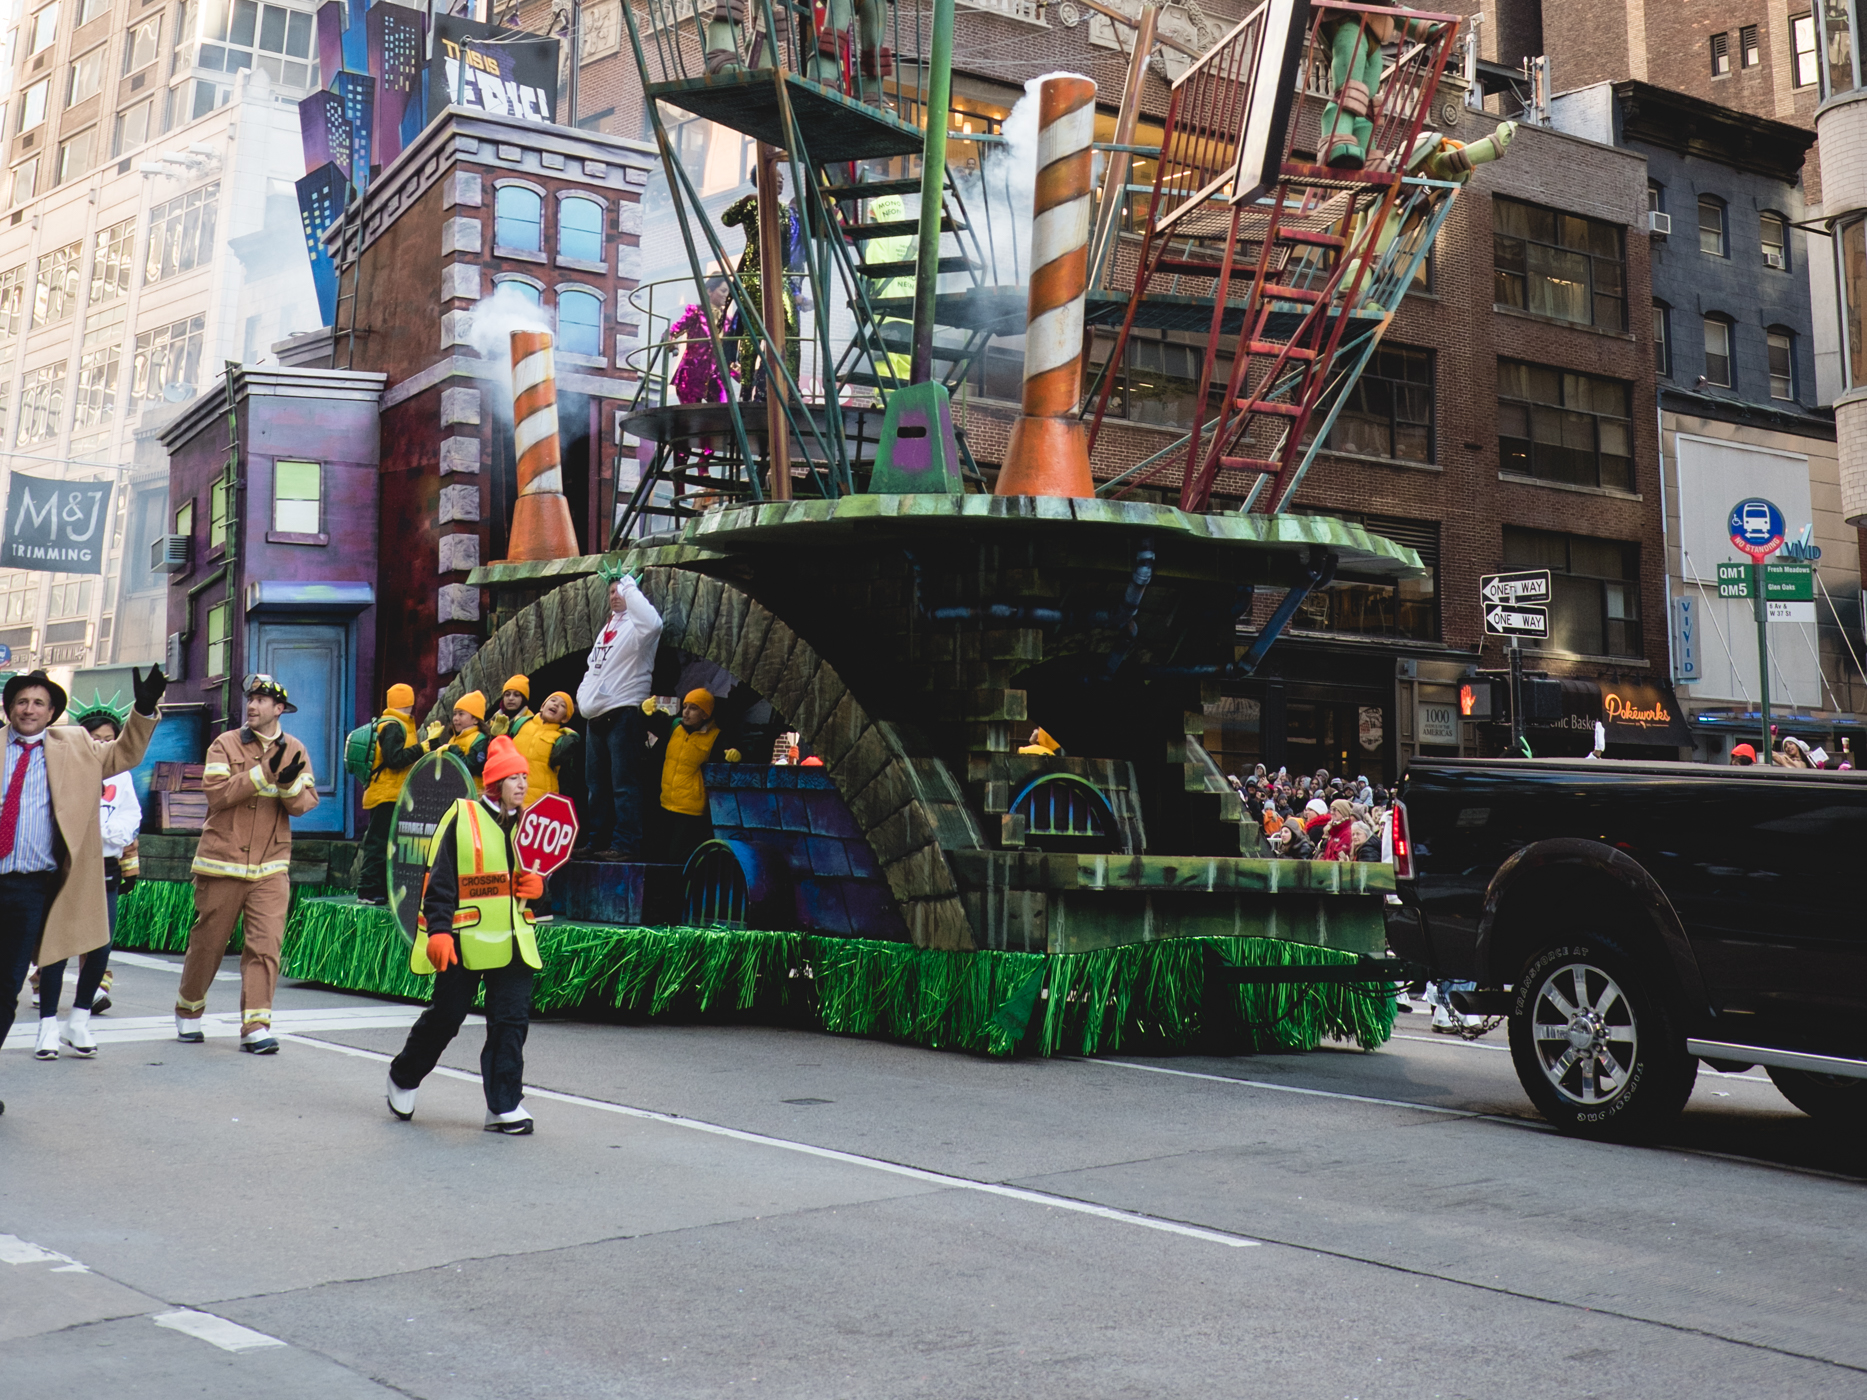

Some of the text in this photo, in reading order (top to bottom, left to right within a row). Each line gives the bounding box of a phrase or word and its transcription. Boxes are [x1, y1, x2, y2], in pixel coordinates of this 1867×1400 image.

[484, 55, 500, 76] IS
[444, 56, 550, 124] EPIC!
[14, 486, 102, 541] M&J
[12, 543, 92, 561] TRIMMING
[1734, 536, 1780, 553] NO STANDING
[1719, 565, 1745, 579] QM1
[1490, 580, 1543, 596] ONE WAY
[1720, 583, 1747, 597] QM5
[1493, 613, 1542, 628] ONE WAY
[1681, 602, 1693, 672] VIVID
[1426, 709, 1450, 723] 1000
[1423, 728, 1452, 737] AMERICAS
[398, 821, 424, 835] TEENAGE
[520, 813, 573, 856] STOP
[462, 874, 507, 887] CROSSING
[469, 886, 499, 897] GUARD
[1515, 946, 1589, 1016] TRANSFORCE AT
